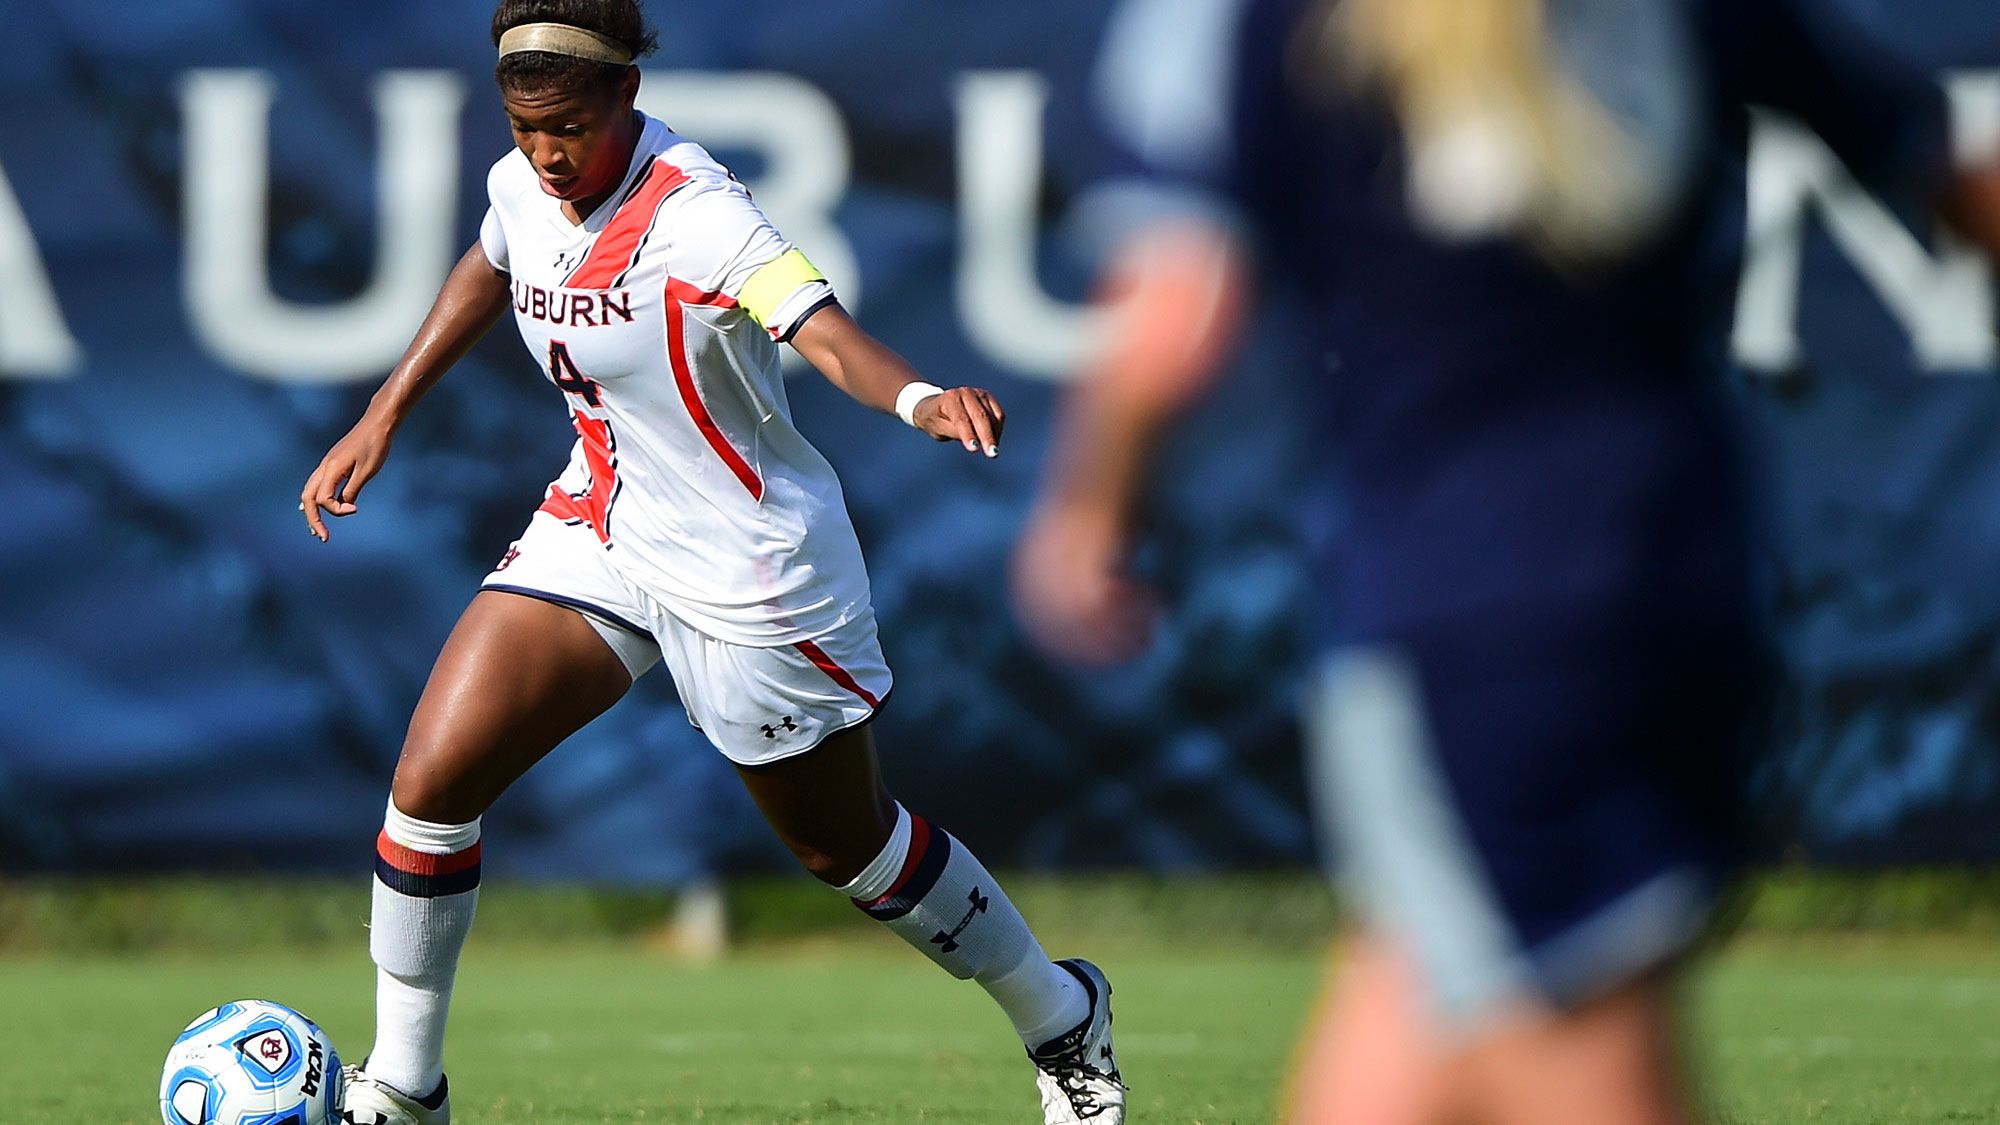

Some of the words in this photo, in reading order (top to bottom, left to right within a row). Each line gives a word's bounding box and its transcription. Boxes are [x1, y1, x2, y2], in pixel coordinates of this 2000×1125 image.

[0, 68, 2000, 384] UUN
[513, 279, 635, 327] UBURN
[548, 338, 604, 409] 4
[300, 1035, 323, 1098] NCAA
